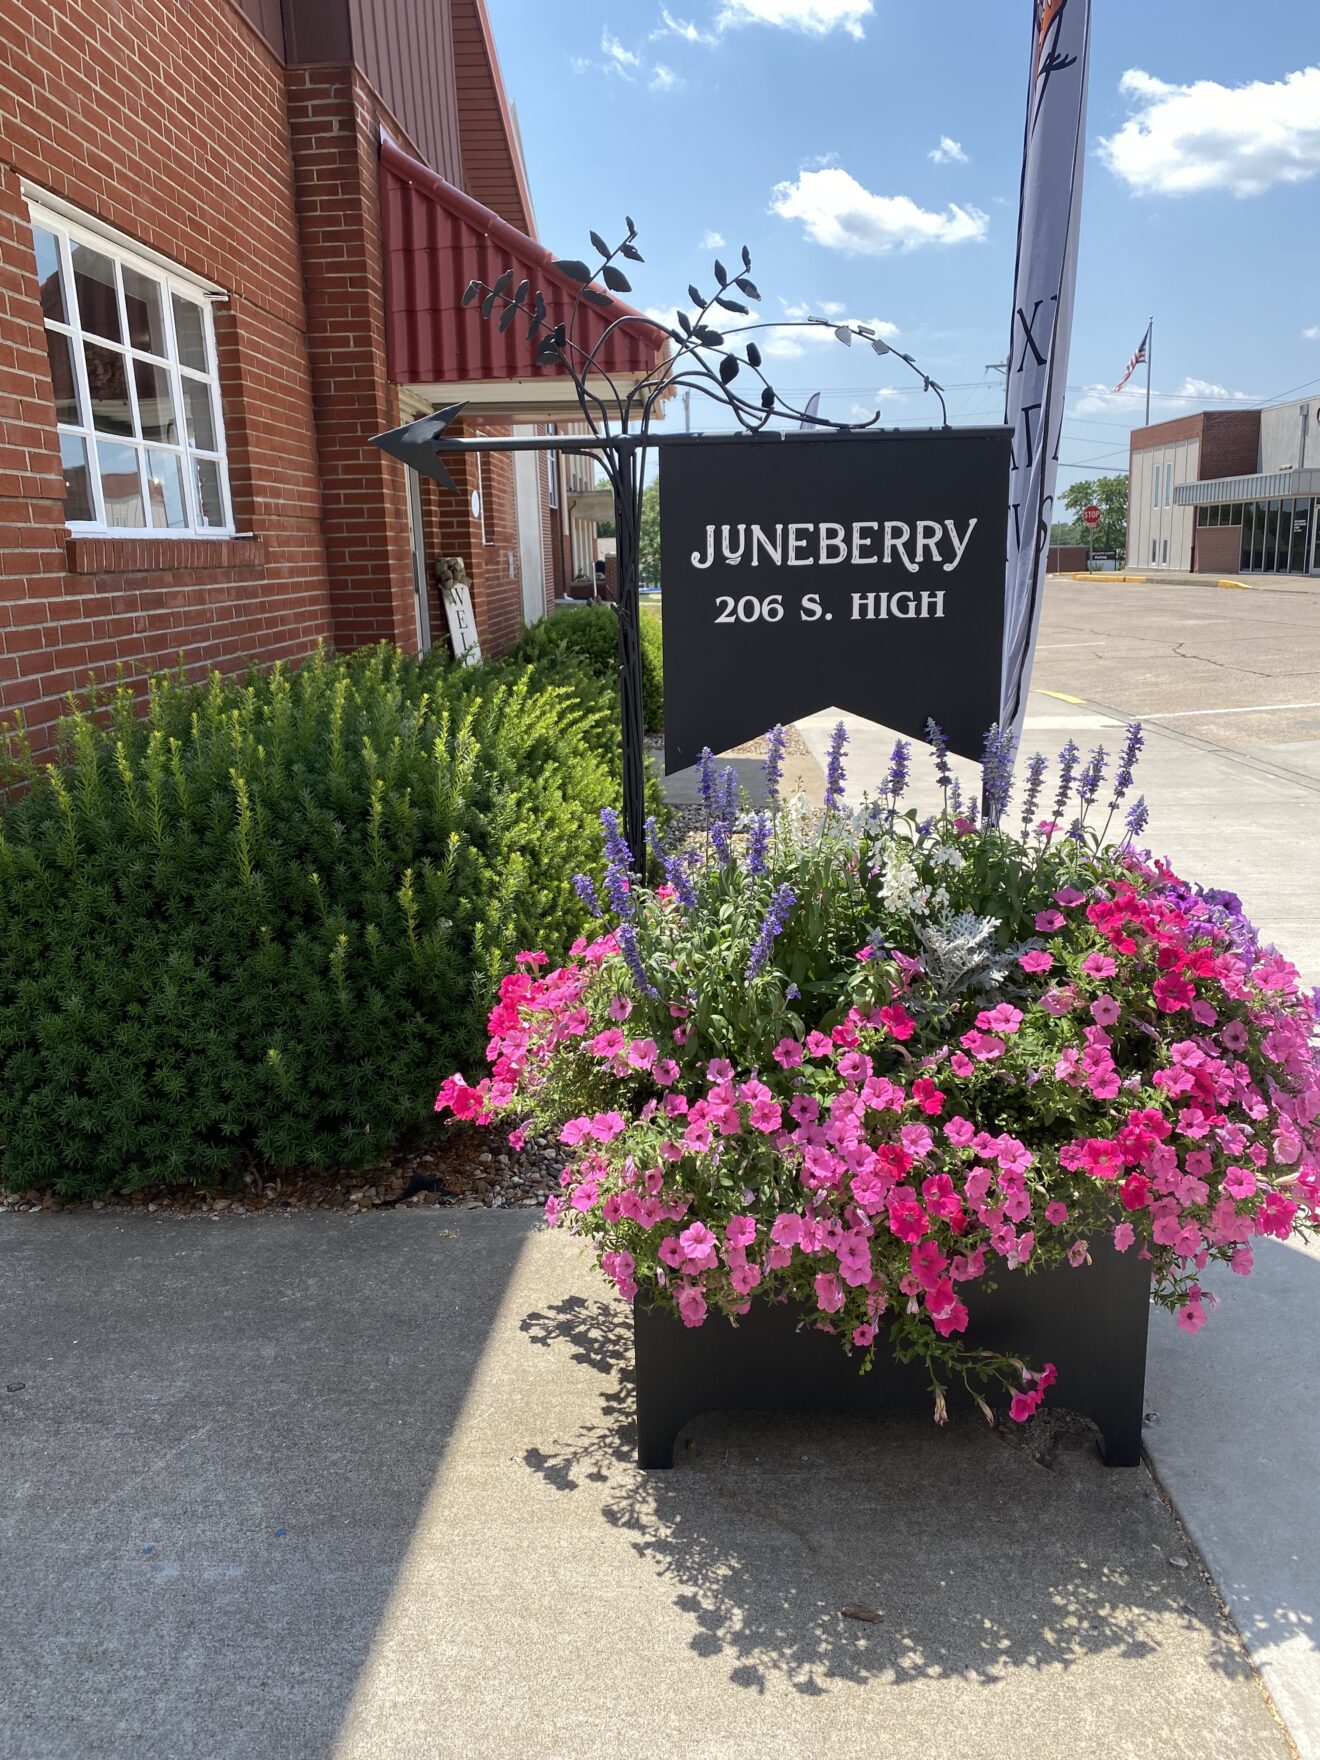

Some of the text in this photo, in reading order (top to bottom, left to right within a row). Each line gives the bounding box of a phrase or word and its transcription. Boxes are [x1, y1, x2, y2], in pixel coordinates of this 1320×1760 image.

[1084, 510, 1100, 519] STOP
[690, 517, 978, 573] JUNEBERRY
[713, 590, 946, 624] 206 S. HIGH
